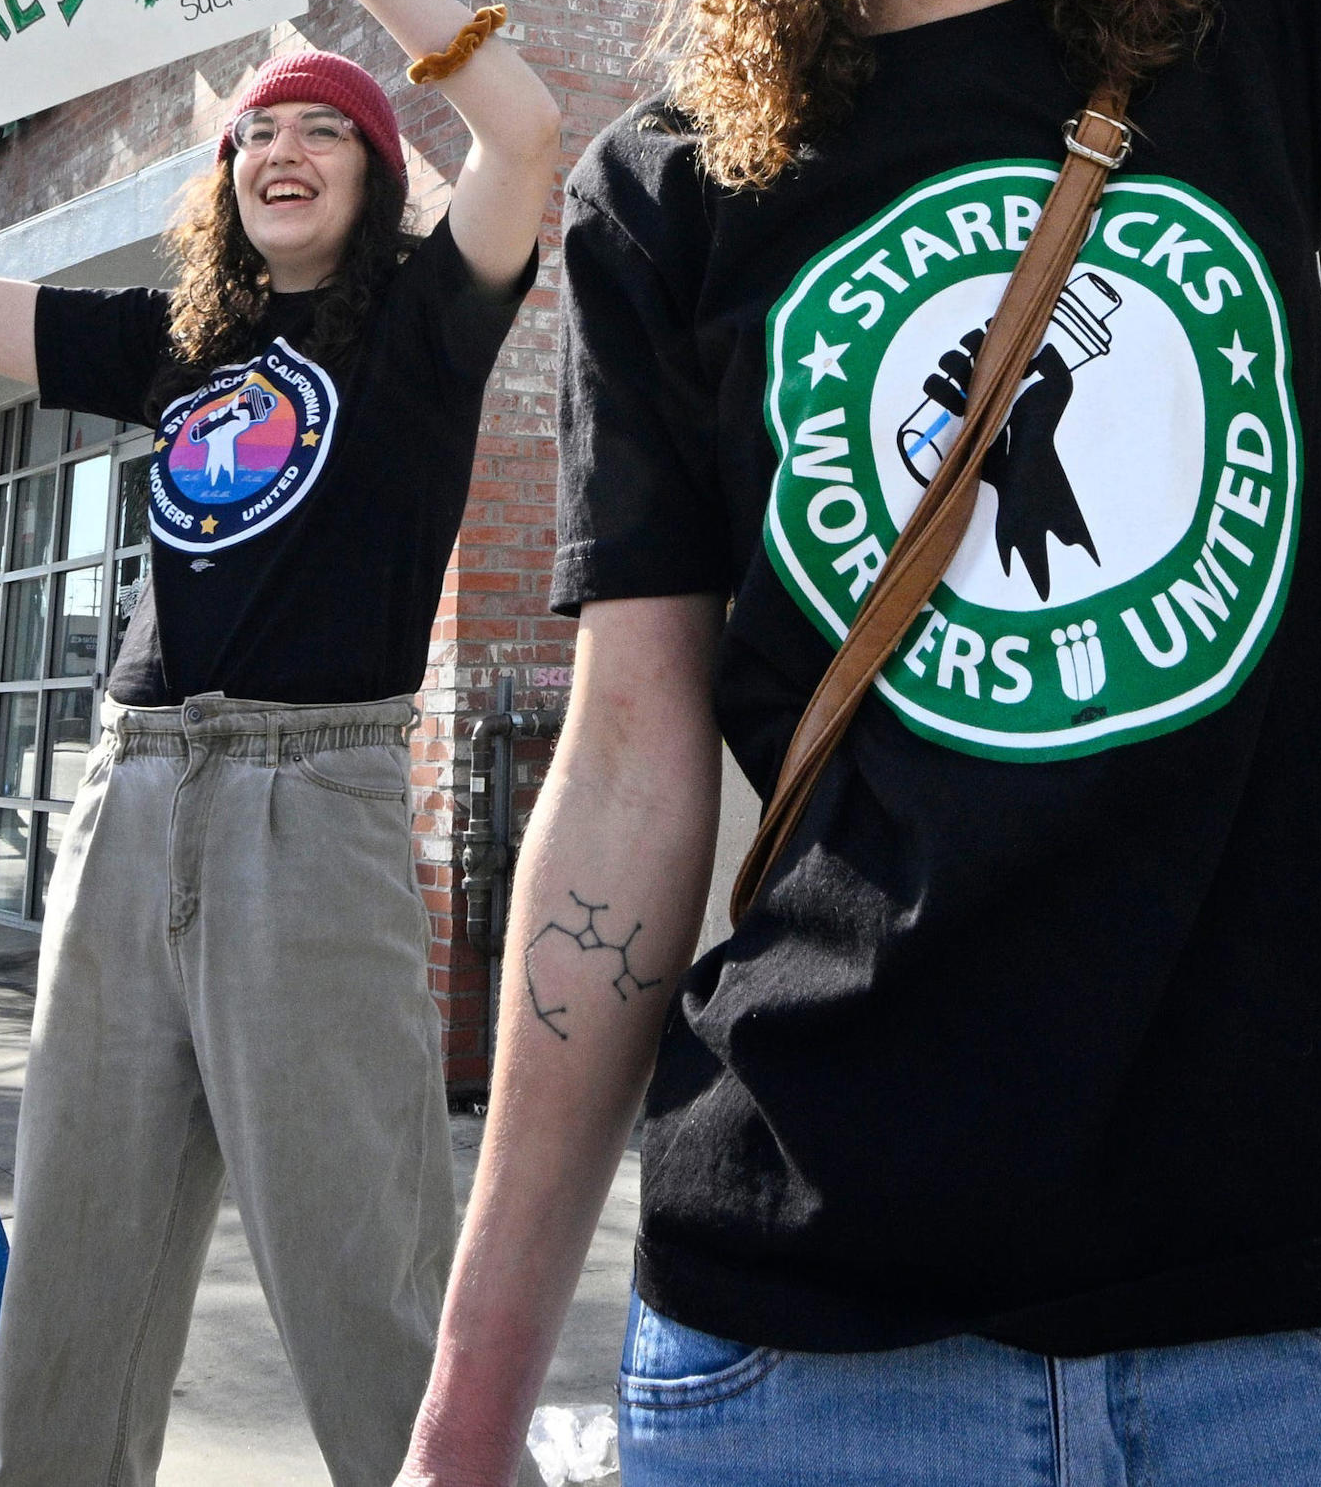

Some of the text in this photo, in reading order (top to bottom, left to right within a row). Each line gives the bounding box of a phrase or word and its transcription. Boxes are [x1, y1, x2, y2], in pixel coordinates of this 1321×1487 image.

[828, 194, 1244, 331] STARBCKS
[266, 354, 321, 427] CALIFORNIA
[150, 462, 300, 530] WORKERS UNITED
[791, 407, 1274, 705] WORERS UNITED
